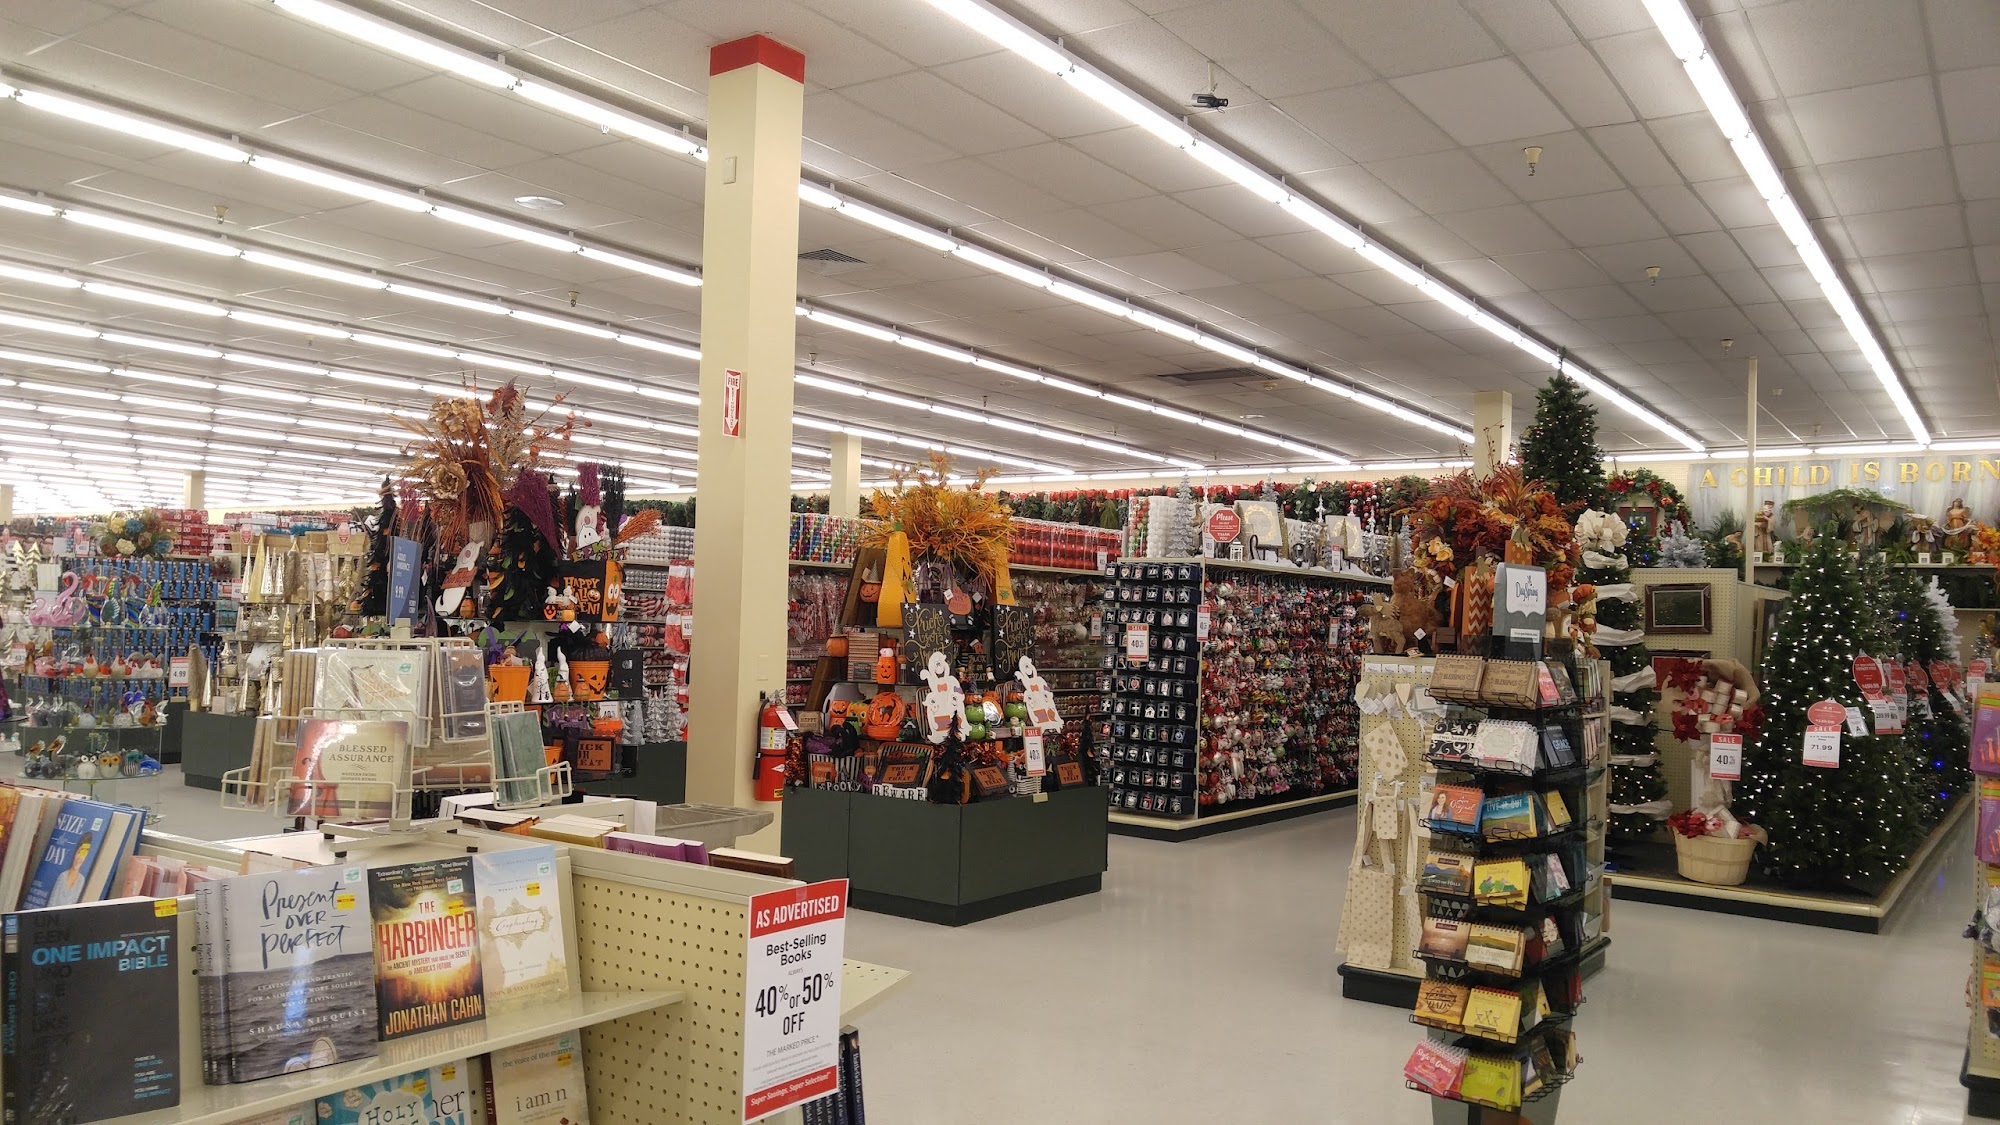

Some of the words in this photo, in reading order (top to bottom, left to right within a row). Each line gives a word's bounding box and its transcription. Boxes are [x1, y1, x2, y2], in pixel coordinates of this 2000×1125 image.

[728, 377, 739, 387] FIRE
[1699, 469, 1718, 488] A
[1730, 466, 1831, 487] CHILD
[1851, 461, 1881, 483] IS
[1900, 460, 2000, 484] BORN
[1216, 513, 1234, 521] Please
[564, 576, 600, 589] HAPPY
[1515, 582, 1539, 602] DaySpring
[329, 753, 394, 763] ASSURANCE
[339, 744, 387, 753] BLESSED
[873, 785, 926, 800] BEWARE
[1450, 800, 1477, 813] Original
[58, 812, 87, 835] SEIZE
[45, 845, 70, 866] DAY
[262, 880, 346, 920] Present
[419, 901, 436, 914] THE
[286, 911, 326, 930] OVER
[756, 909, 771, 929] AS
[773, 895, 840, 925] ADVERTISED
[496, 914, 538, 933] Captivating
[377, 910, 478, 963] HARBINGER
[766, 934, 827, 957] Best-Selling
[32, 945, 82, 966] ONE
[87, 935, 170, 960] IMPACT
[393, 961, 411, 970] ANCIENT
[412, 957, 431, 966] MYSTERY
[455, 950, 470, 958] SECRET
[780, 949, 812, 966] Books
[118, 954, 169, 972] BIBLE
[257, 981, 290, 991] LEAVING
[322, 972, 354, 982] FRANTIC
[310, 995, 336, 1004] LIVING
[755, 984, 789, 1018] 40%
[789, 994, 801, 1009] or
[802, 972, 834, 1005] 50%
[1428, 1000, 1451, 1010] DADS
[250, 1021, 303, 1036] SHAUNA
[307, 1009, 368, 1025] NIEQUIST
[386, 1001, 448, 1036] JONATHAN
[451, 994, 483, 1021] CAHN
[783, 1012, 805, 1036] OFF
[766, 1048, 777, 1058] THE
[777, 1041, 800, 1054] MARKED
[800, 1036, 816, 1047] PRICE
[514, 1057, 530, 1065] voice
[539, 1051, 550, 1060] the
[1417, 1049, 1430, 1060] Style
[1435, 1060, 1452, 1074] Grace
[516, 1096, 522, 1113] i
[525, 1092, 551, 1110] am
[556, 1088, 568, 1102] n
[750, 1094, 767, 1107] Super
[789, 1081, 805, 1092] Super
[366, 1101, 418, 1125] HOLY
